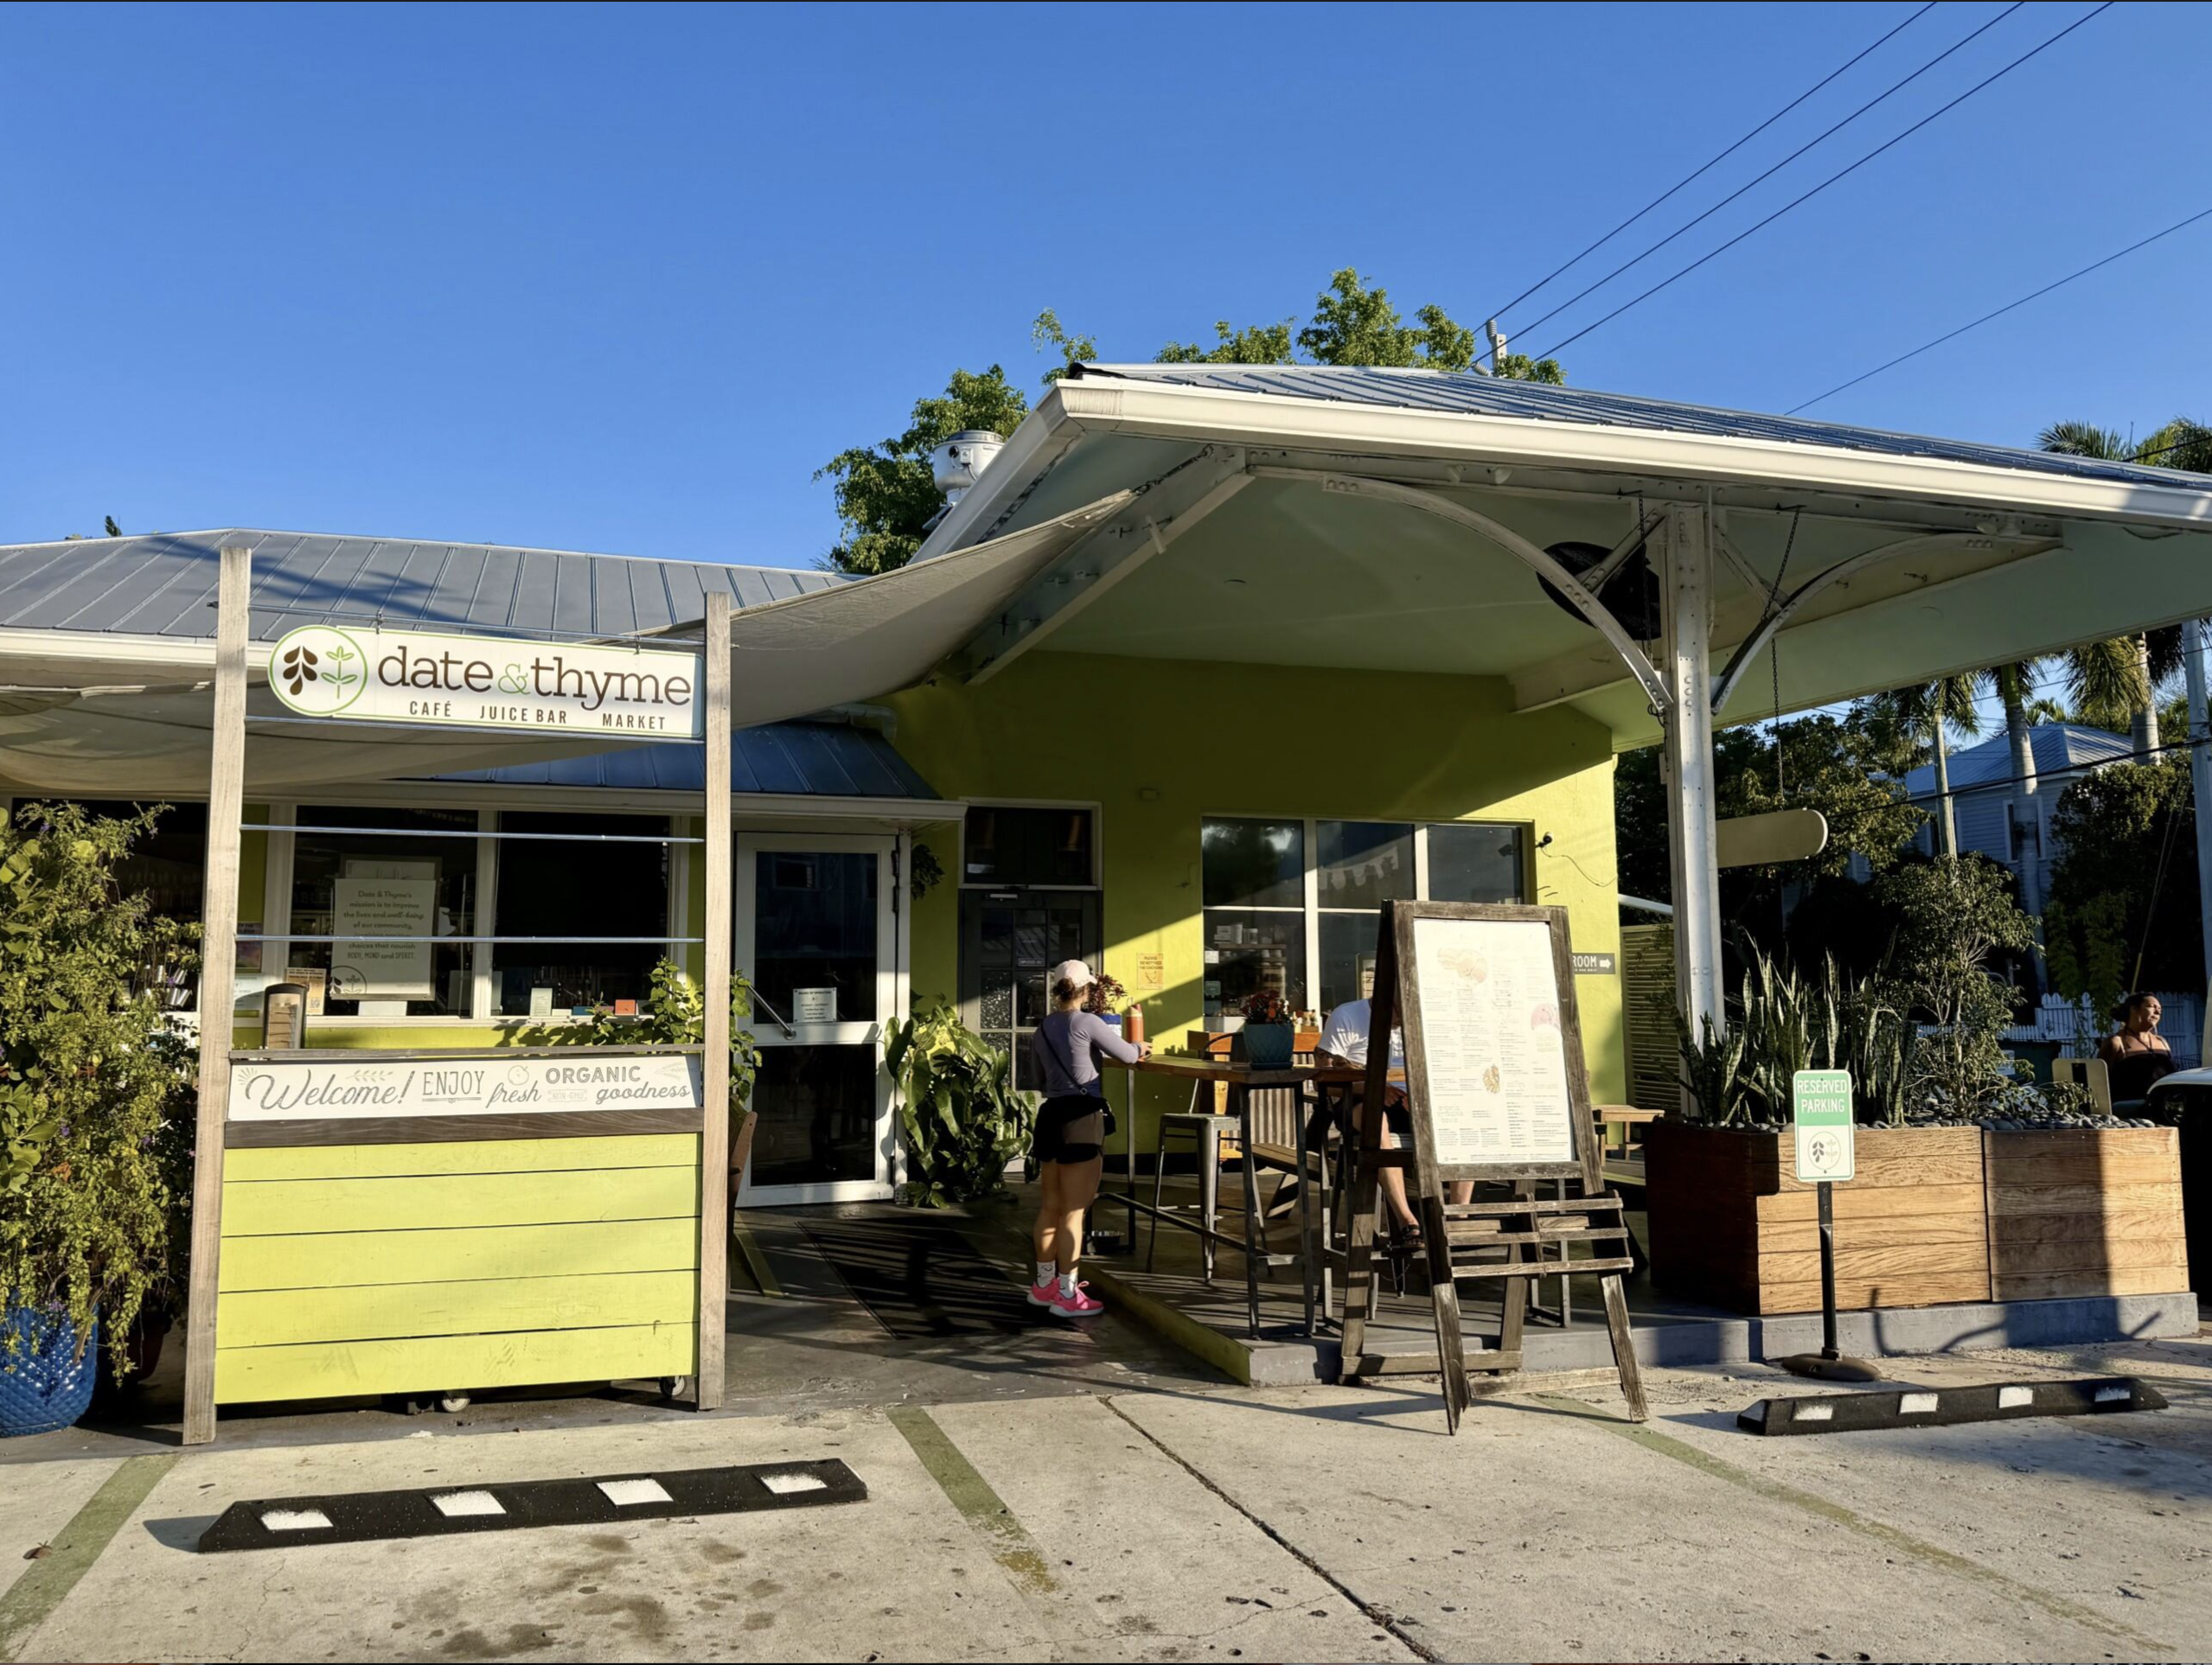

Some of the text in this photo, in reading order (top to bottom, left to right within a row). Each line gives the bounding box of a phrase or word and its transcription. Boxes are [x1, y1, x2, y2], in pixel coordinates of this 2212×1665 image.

[409, 700, 665, 730] CAFÉ JUICE BAR MARKET
[546, 1066, 641, 1085] ORGANIC
[245, 1069, 542, 1110] Welcome! ENJOY fresh
[596, 1081, 690, 1105] goodness
[1797, 1080, 1847, 1094] RESERVED
[1801, 1099, 1844, 1113] PARKING
